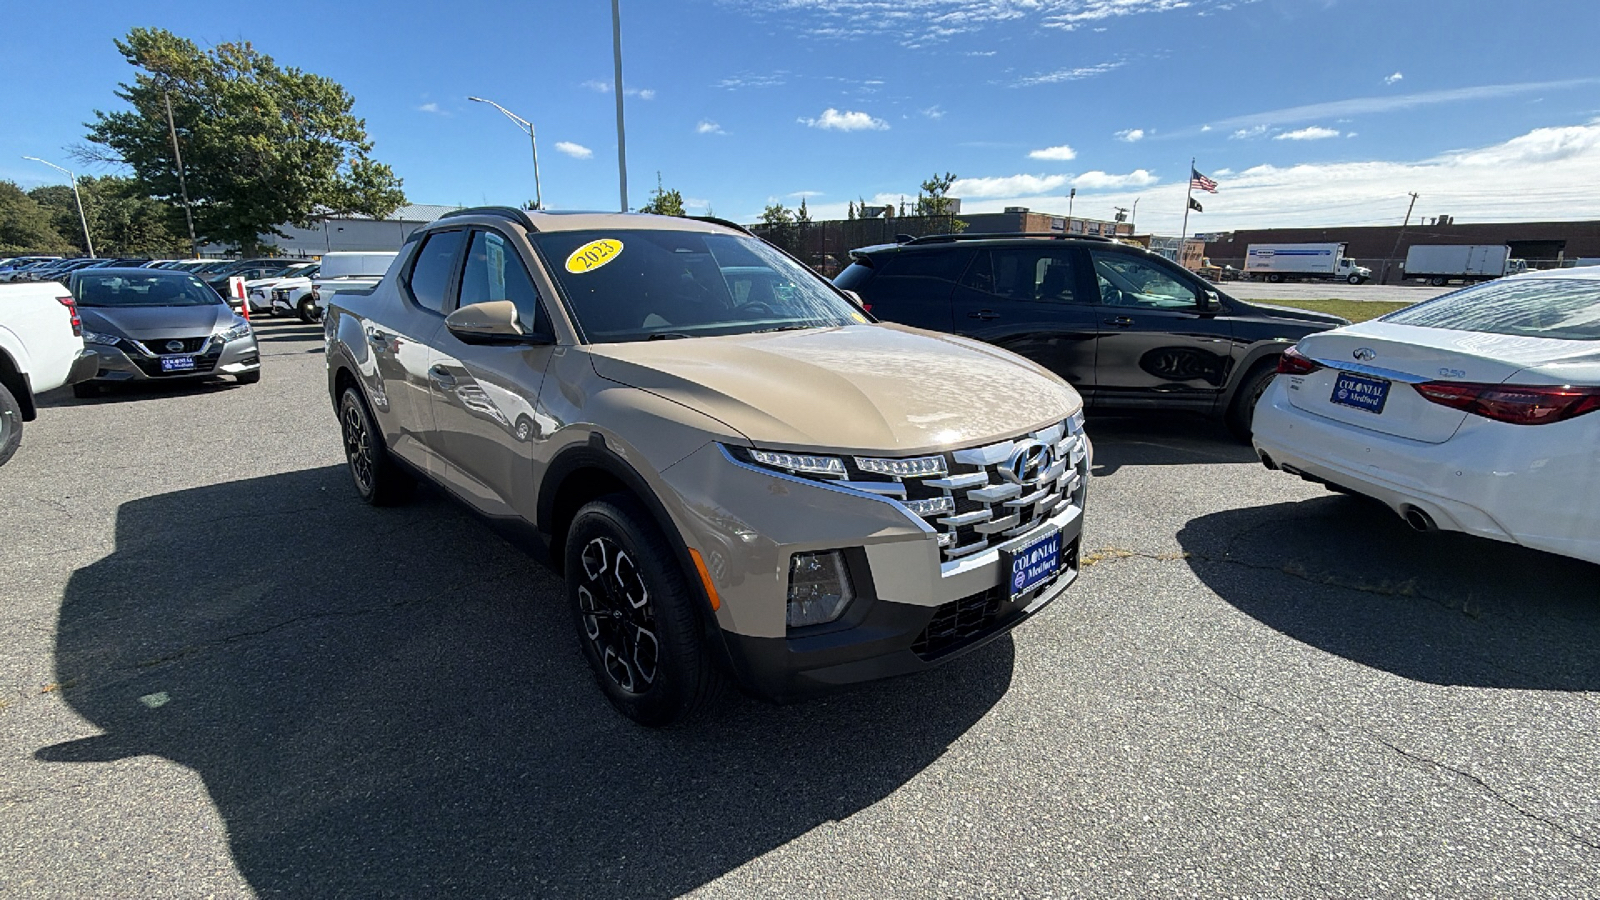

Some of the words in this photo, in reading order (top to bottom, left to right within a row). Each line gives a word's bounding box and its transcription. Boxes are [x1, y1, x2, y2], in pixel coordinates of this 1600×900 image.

[576, 241, 614, 268] 2023
[1439, 367, 1466, 379] Q50
[1339, 379, 1384, 397] COLONIAL
[1350, 392, 1379, 406] Medford
[1013, 540, 1059, 574] COLONIAL
[1027, 556, 1056, 580] Medford
